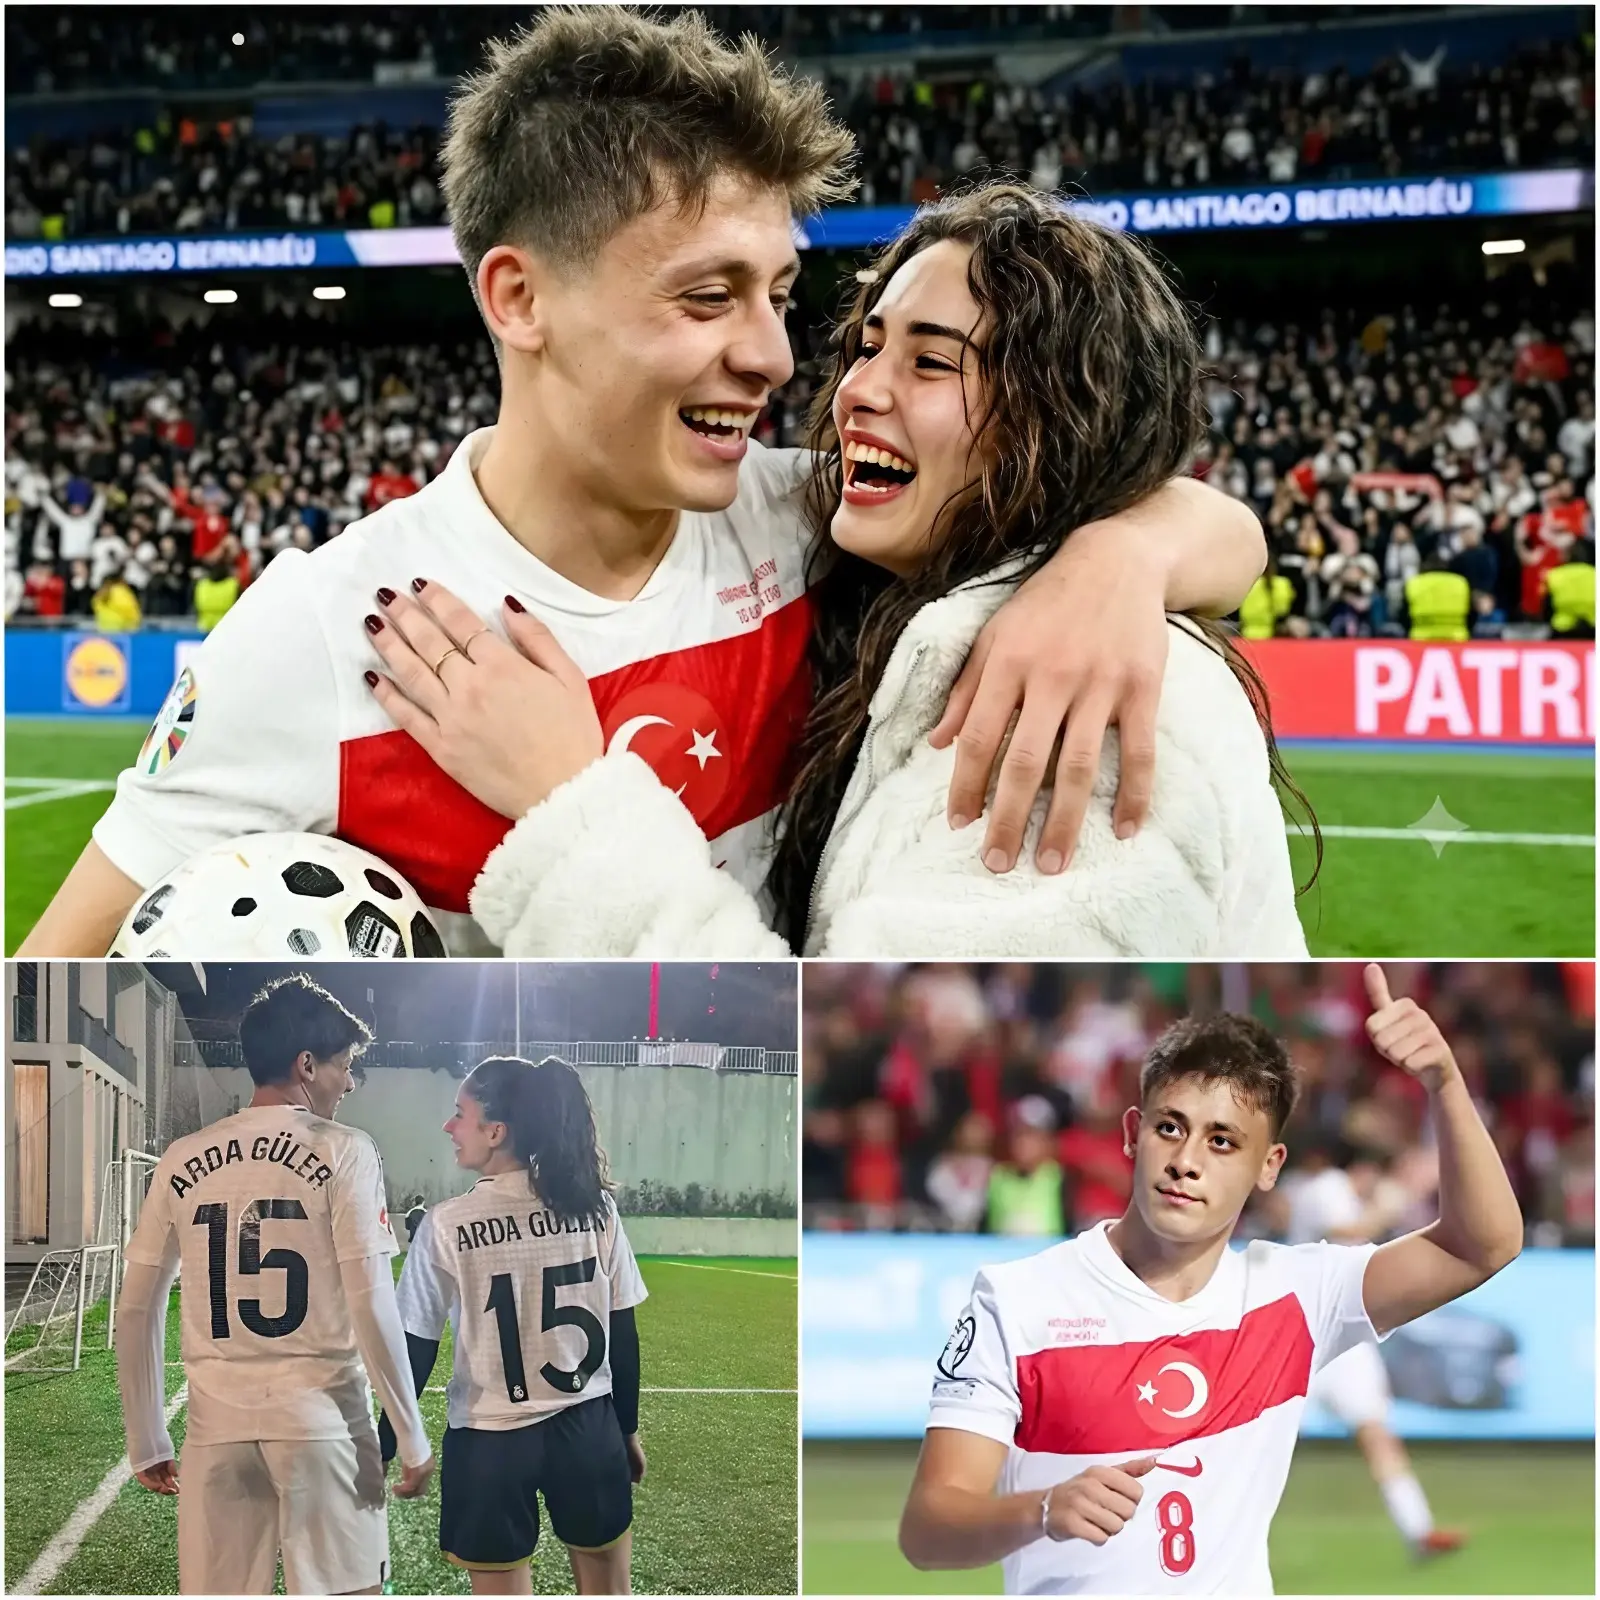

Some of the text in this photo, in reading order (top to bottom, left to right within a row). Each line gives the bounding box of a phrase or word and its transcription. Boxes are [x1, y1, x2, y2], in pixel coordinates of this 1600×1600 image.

[1132, 190, 1291, 231] SANTIAGO
[1294, 177, 1473, 220] BERNABÉU
[50, 240, 176, 274] SANTIAGO
[177, 233, 316, 269] BERNABÉU
[170, 1131, 333, 1200] ARDA GÜLER
[456, 1215, 522, 1252] ARDA
[192, 1198, 309, 1340] 15
[484, 1256, 606, 1404] 15
[1155, 1491, 1195, 1577] 8
